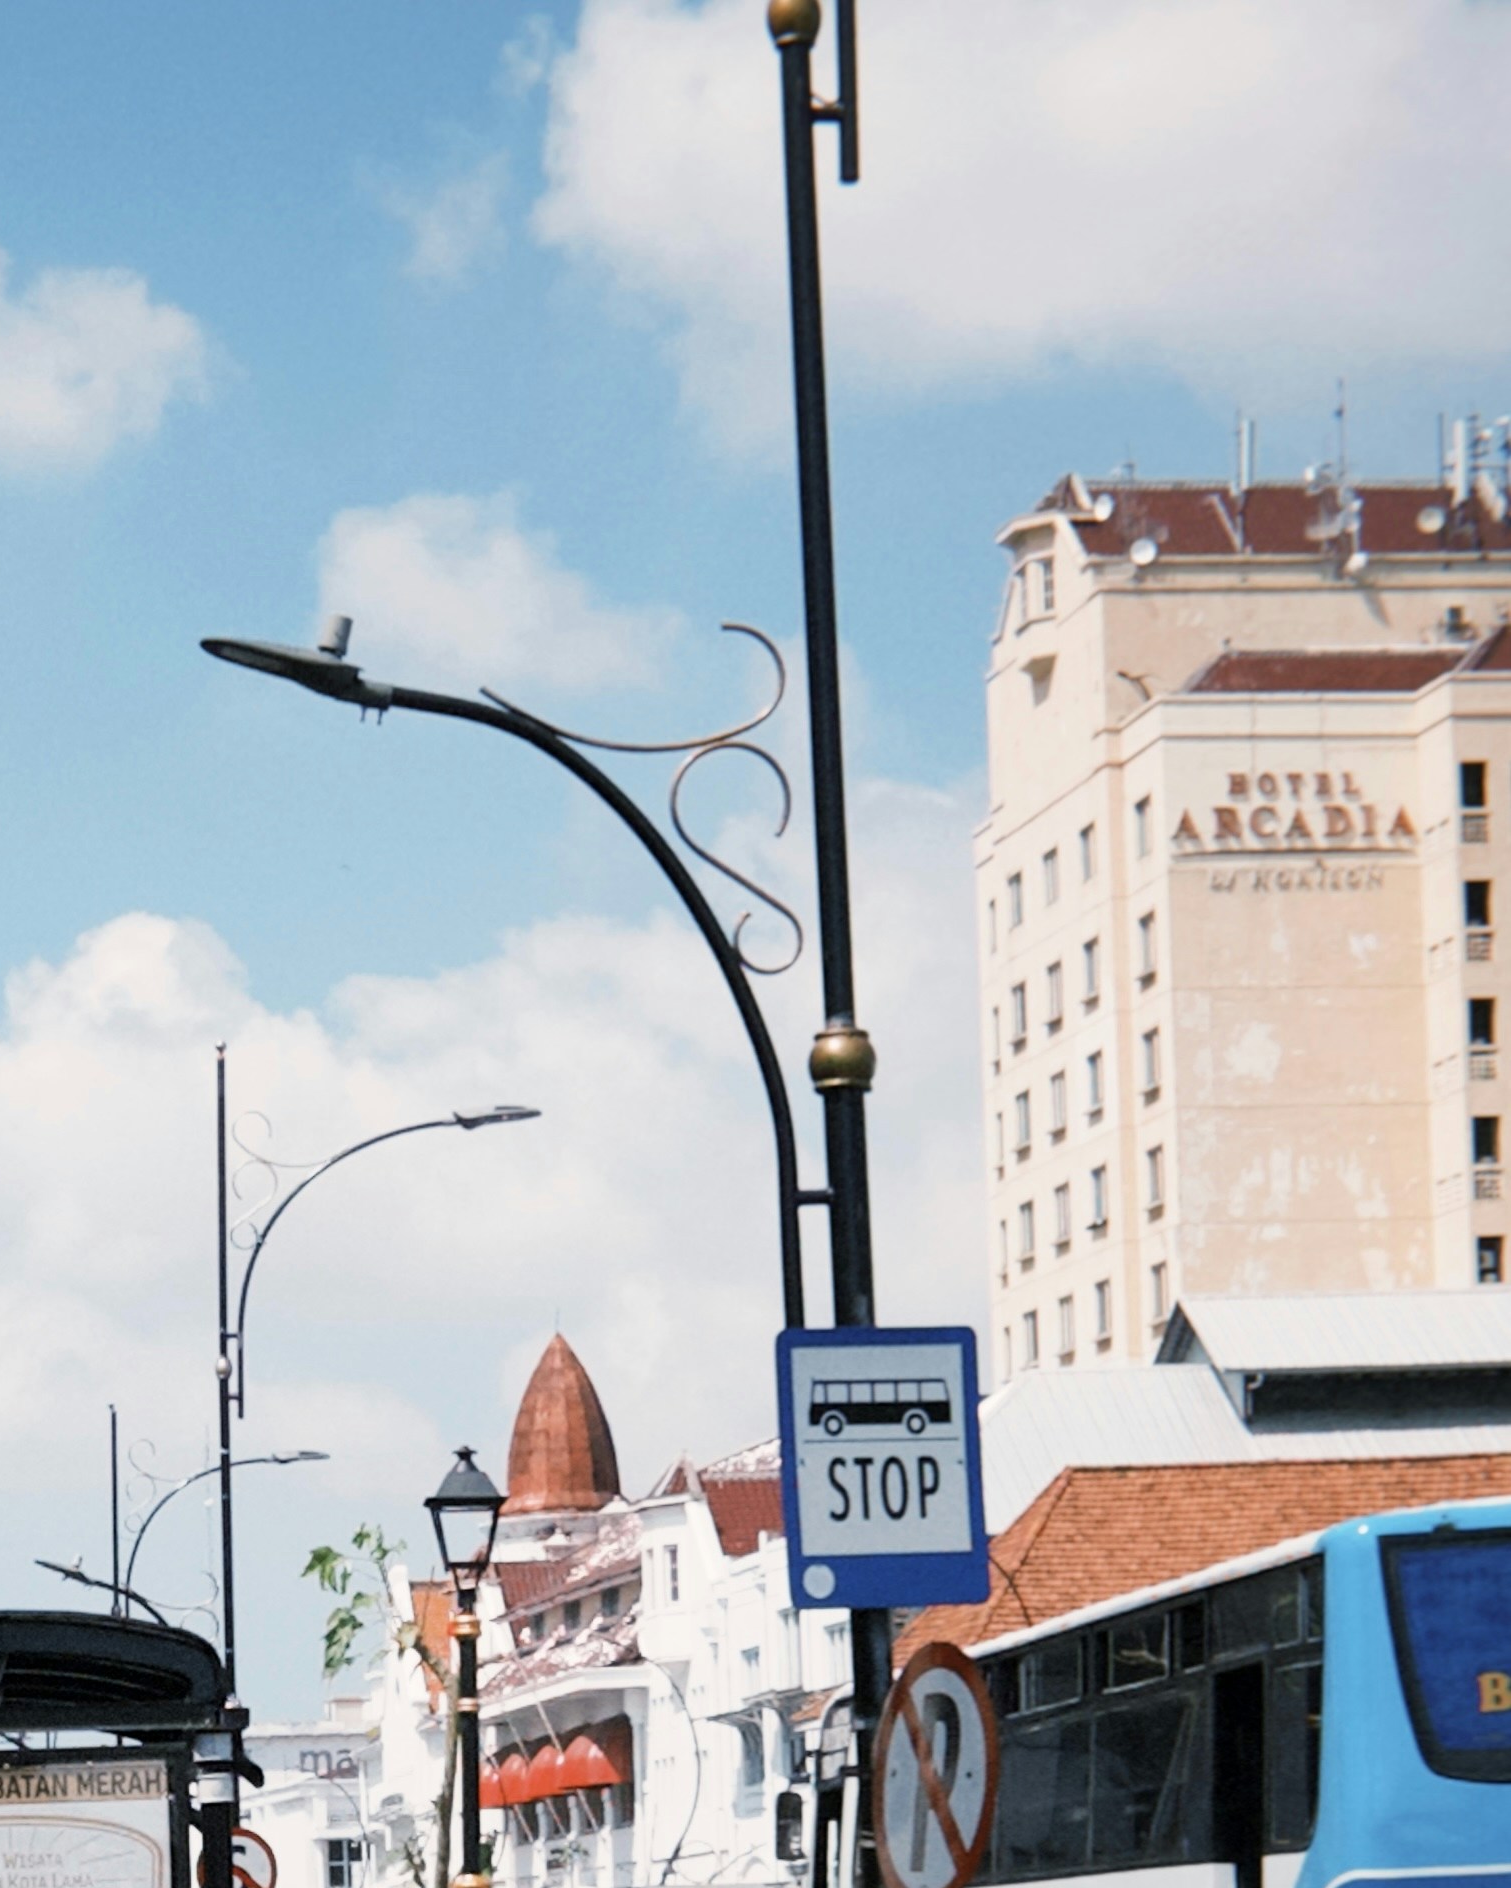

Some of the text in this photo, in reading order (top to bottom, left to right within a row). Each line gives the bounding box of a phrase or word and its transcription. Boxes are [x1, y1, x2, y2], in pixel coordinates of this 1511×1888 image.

[1227, 771, 1361, 797] HOTEL
[1171, 804, 1417, 841] ARCADIA
[827, 1455, 940, 1522] STOP
[76, 1768, 162, 1797] MERAH
